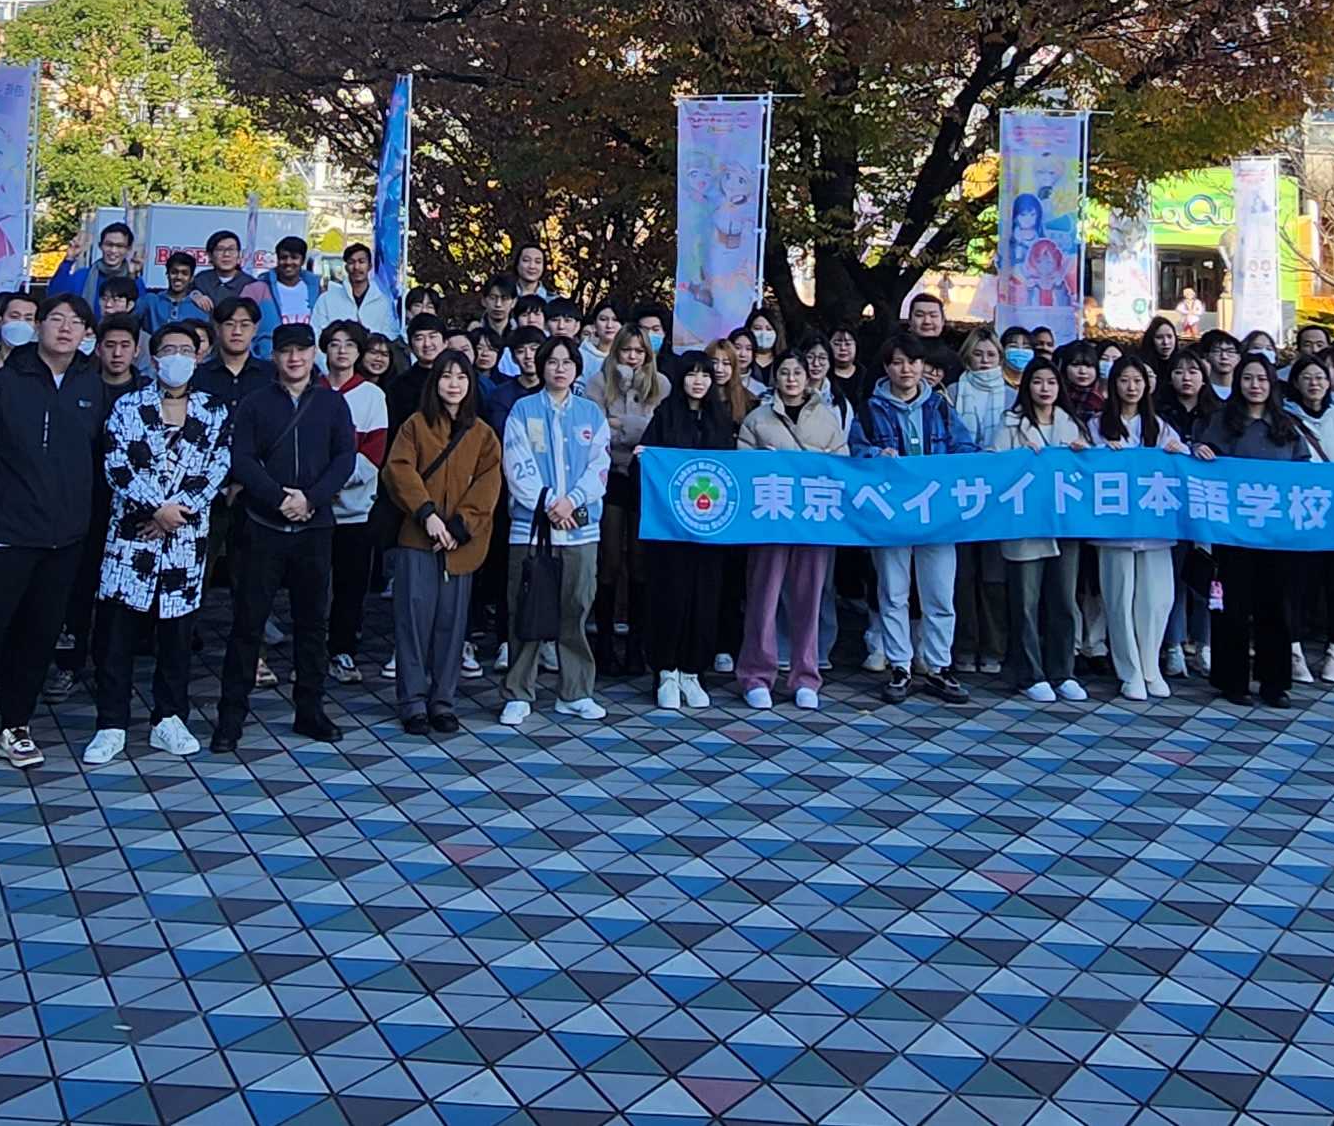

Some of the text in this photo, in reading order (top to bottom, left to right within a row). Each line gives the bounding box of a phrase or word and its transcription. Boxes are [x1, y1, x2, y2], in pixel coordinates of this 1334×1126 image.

[1146, 182, 1235, 231] LaQu
[513, 458, 537, 481] 25
[751, 471, 1333, 530] 東京ベイサイド日本語学校
